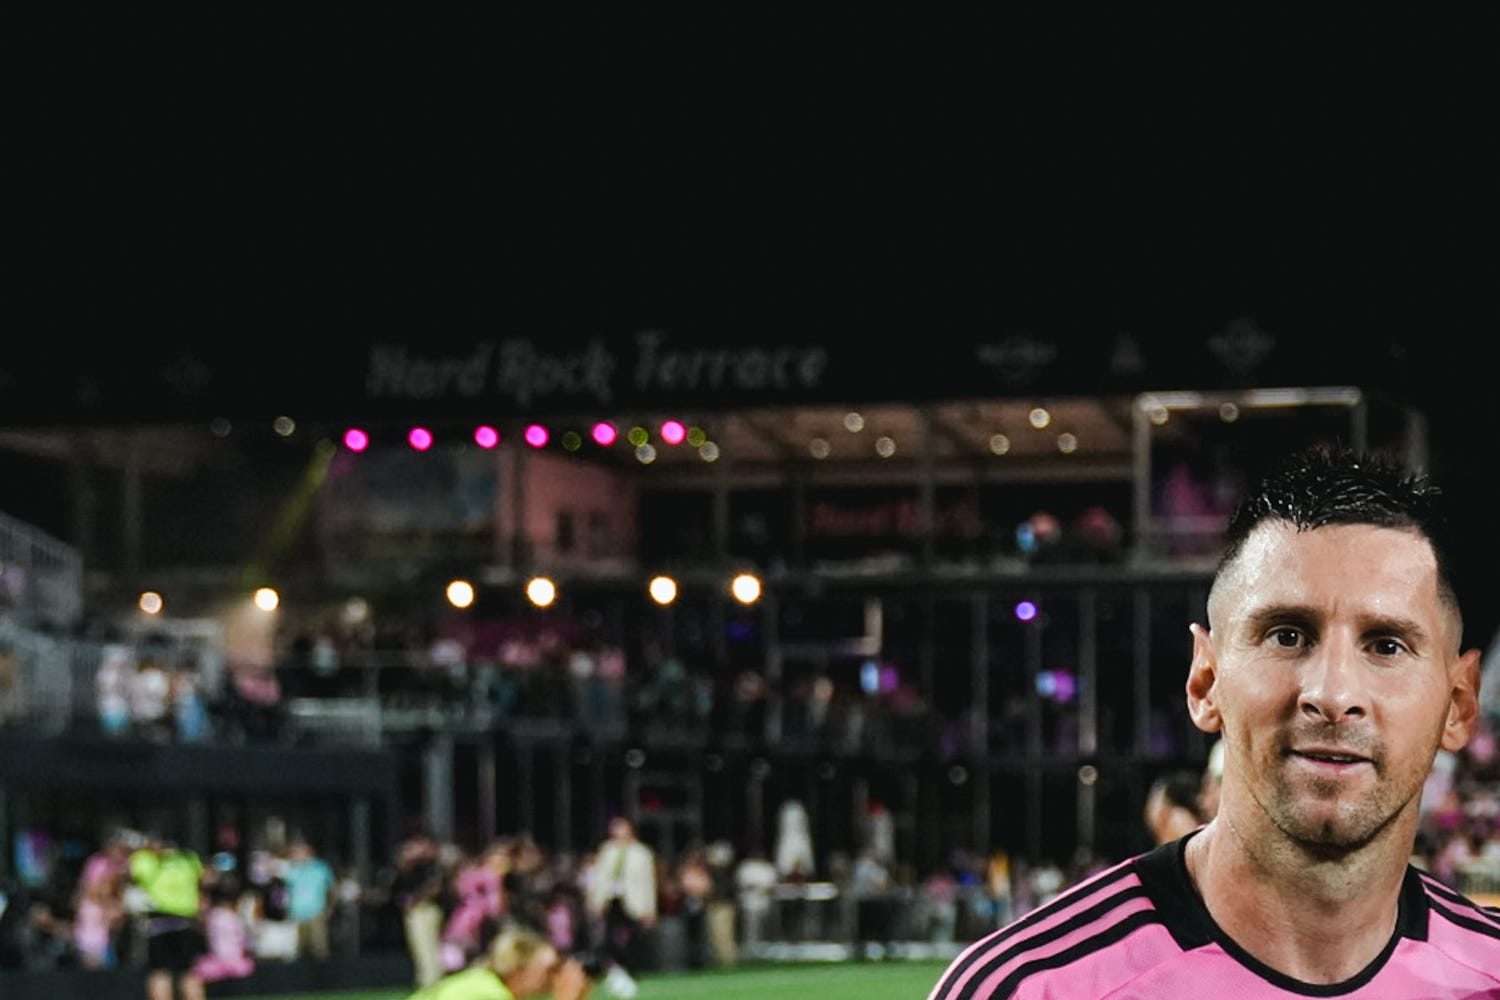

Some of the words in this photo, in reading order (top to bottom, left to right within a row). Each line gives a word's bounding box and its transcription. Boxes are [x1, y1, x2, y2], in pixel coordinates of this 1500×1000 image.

[366, 339, 496, 398] Hard
[496, 336, 617, 409] Rock
[633, 328, 829, 391] Terrace
